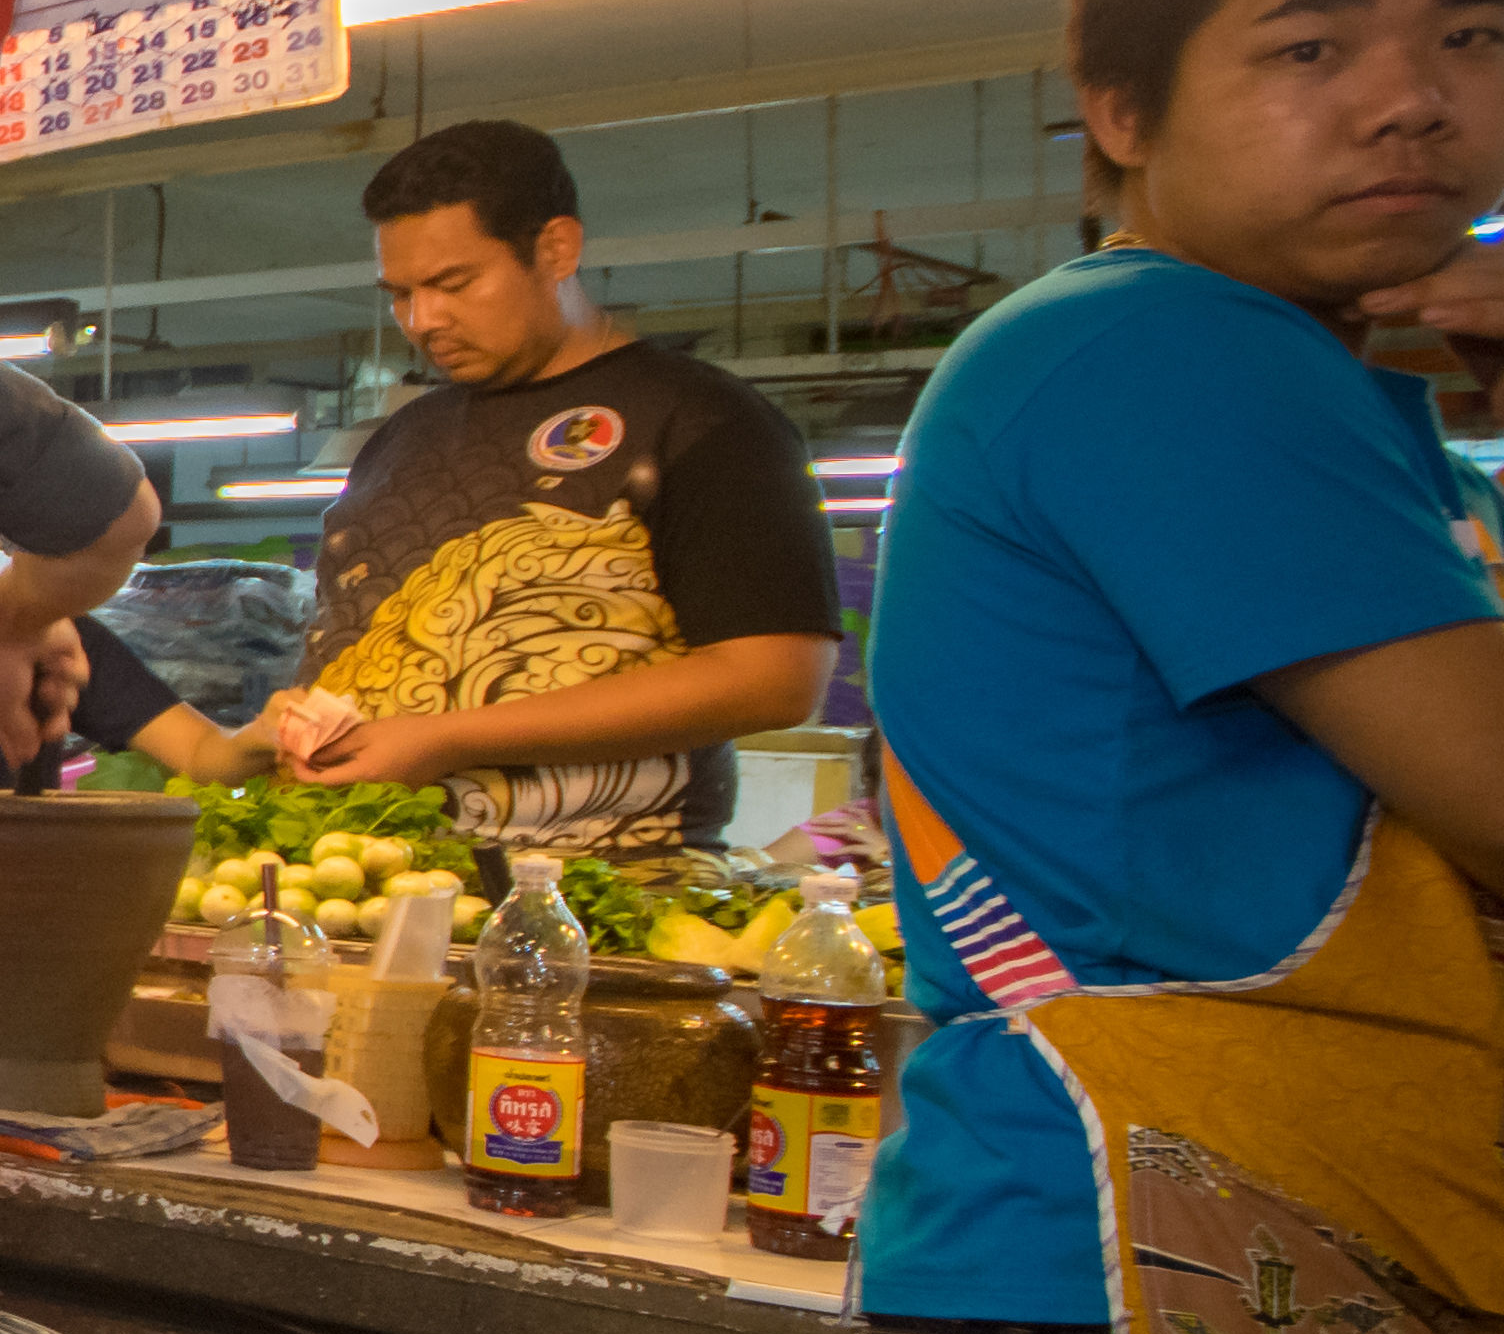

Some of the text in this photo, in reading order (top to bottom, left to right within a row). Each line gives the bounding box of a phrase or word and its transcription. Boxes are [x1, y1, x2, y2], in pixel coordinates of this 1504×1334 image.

[40, 81, 71, 105] 19
[84, 72, 118, 95] 20
[132, 60, 164, 84] 21
[181, 49, 217, 74] 22
[232, 37, 270, 64] 23
[286, 26, 324, 51] 24
[41, 51, 71, 75] 12
[136, 31, 167, 54] 14
[184, 19, 217, 42] 15
[39, 111, 71, 136] 26
[83, 102, 115, 125] 27
[131, 90, 166, 115] 28
[181, 80, 216, 105] 29
[233, 69, 270, 94] 30
[286, 59, 321, 84] 31
